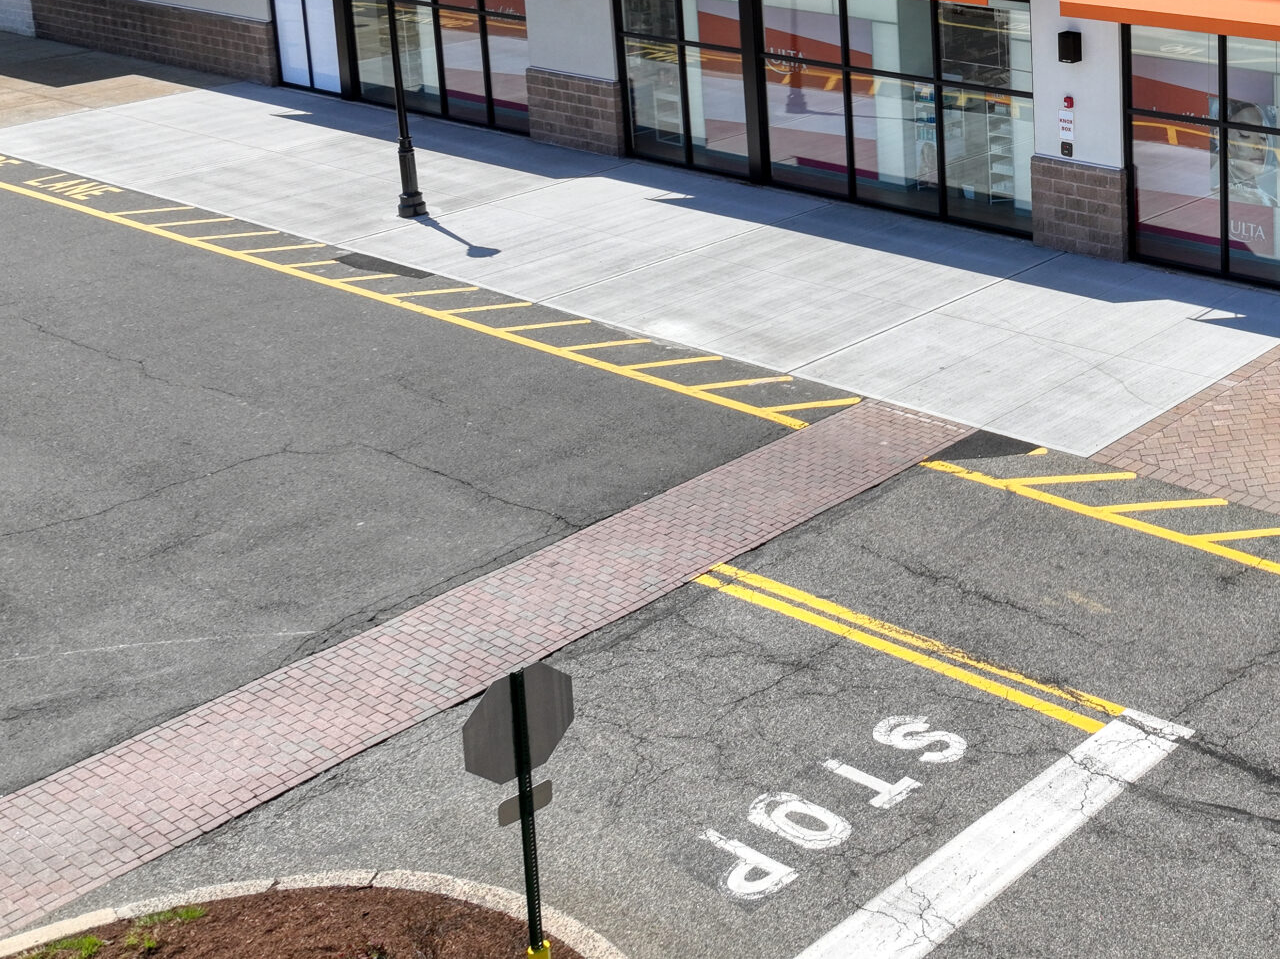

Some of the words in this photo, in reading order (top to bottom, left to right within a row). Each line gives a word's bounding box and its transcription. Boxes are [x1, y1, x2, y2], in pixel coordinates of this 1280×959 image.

[22, 173, 125, 200] LANE
[1230, 220, 1266, 240] ULTA
[698, 714, 969, 901] STOP
